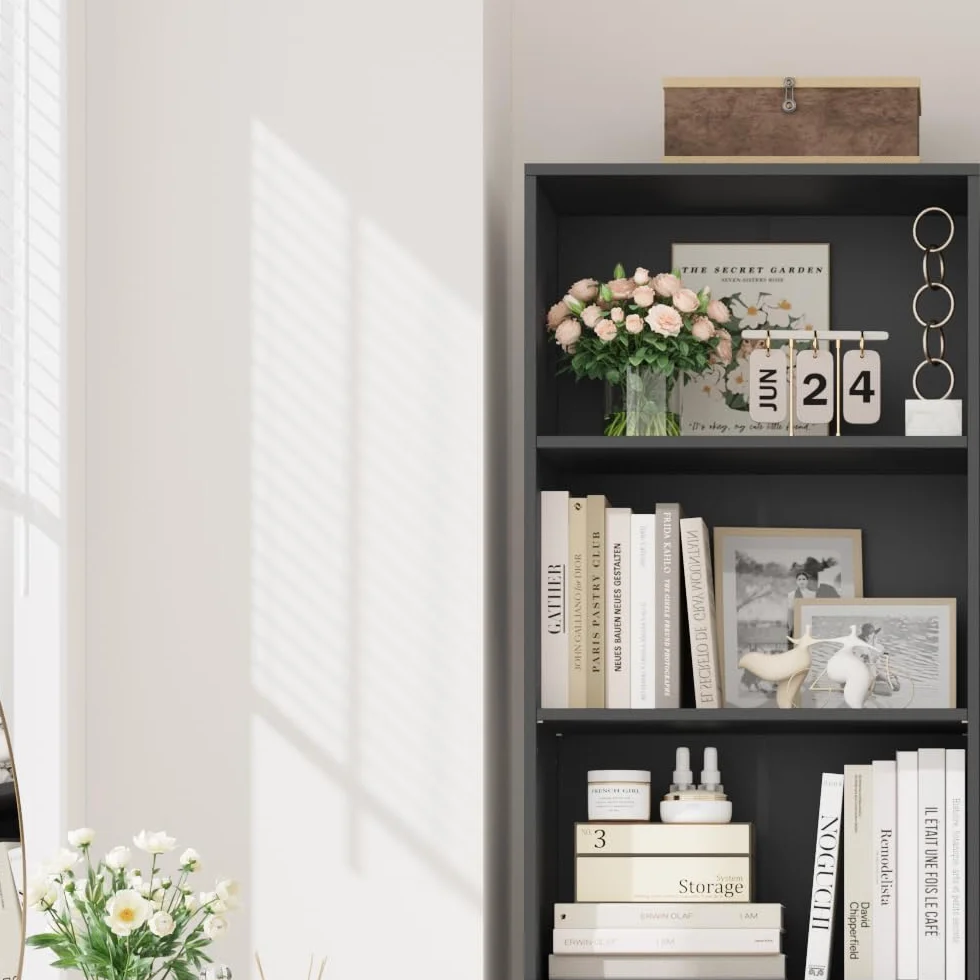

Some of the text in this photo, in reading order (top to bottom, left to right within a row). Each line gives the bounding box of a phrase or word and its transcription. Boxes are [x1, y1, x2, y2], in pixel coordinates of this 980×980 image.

[681, 266, 823, 274] THE SECRET GARDEN
[759, 369, 777, 412] JUN
[803, 373, 828, 405] 2
[848, 370, 875, 404] 4
[664, 511, 672, 574] FRIDA KAHLO
[547, 564, 562, 635] GATHER
[573, 553, 583, 671] JOHN GALLIANO for DIOR
[592, 531, 601, 673] PARIS PASTRY CLUB
[613, 543, 622, 672] NEUES BAUEN NEUES GESTALTEN
[594, 829, 606, 849] 3
[881, 828, 893, 907] Remodelista
[678, 878, 744, 898] Storage
[811, 814, 839, 931] NOGUCHI
[924, 806, 940, 937] IL ÉTAIT UNE FOIS LE CAFÉ
[849, 901, 860, 960] Chipperfield
[861, 901, 871, 928] David
